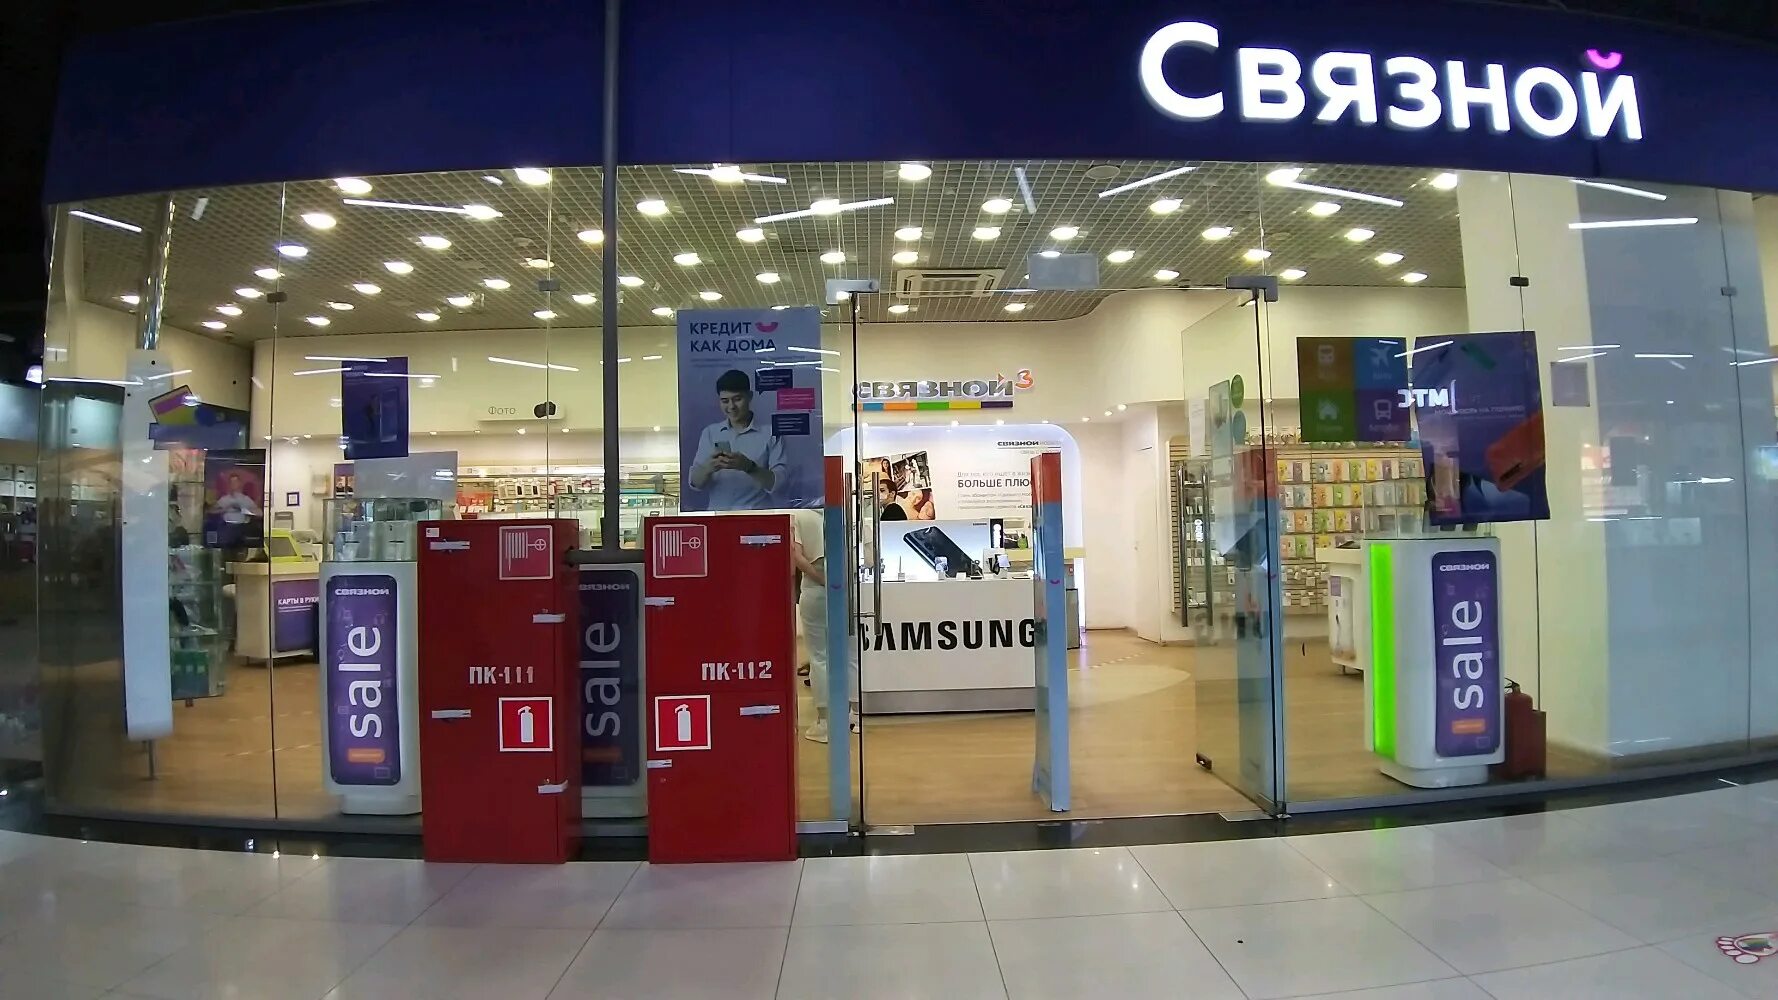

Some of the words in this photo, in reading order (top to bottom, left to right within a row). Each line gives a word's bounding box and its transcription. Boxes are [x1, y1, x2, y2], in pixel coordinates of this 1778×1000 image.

[689, 322, 752, 336] КРЕДИТ
[690, 340, 722, 352] КАК
[726, 339, 776, 353] ДОМА
[957, 479, 1003, 488] БОЛЬШЕ
[1005, 478, 1031, 487] ПЛЮ
[1443, 600, 1484, 710] sale
[469, 666, 534, 684] ПК-111
[580, 622, 621, 737] sale
[701, 661, 772, 681] ПК-112
[338, 626, 382, 738] sale
